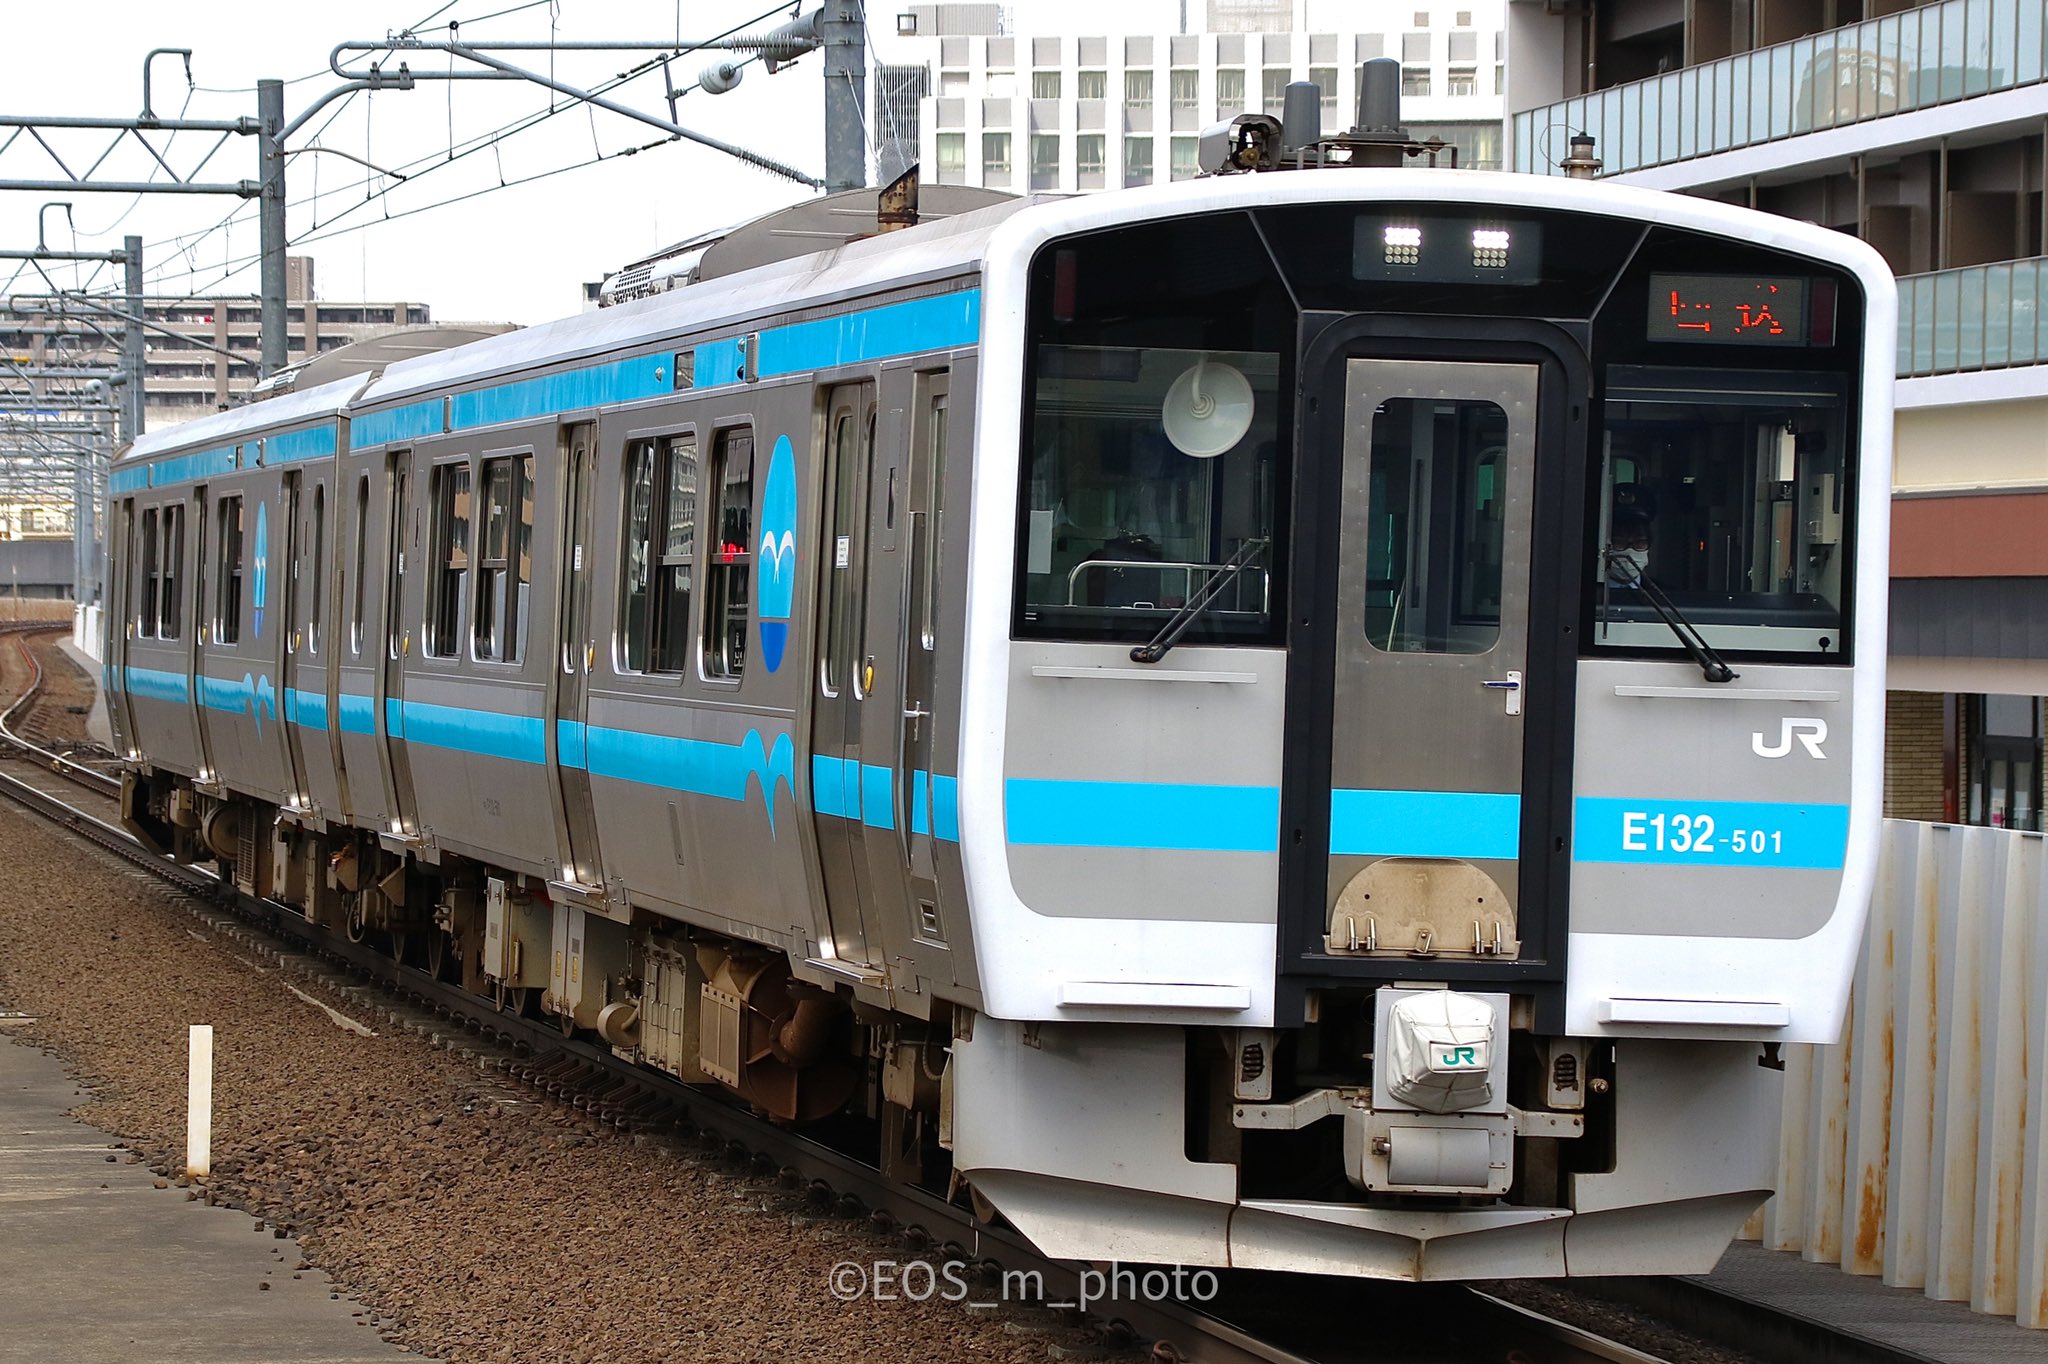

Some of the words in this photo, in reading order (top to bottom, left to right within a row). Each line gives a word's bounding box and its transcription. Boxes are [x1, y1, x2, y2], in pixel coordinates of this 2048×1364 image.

[1752, 717, 1828, 759] JR
[1622, 811, 1782, 854] E132-501
[1442, 1046, 1475, 1066] JR
